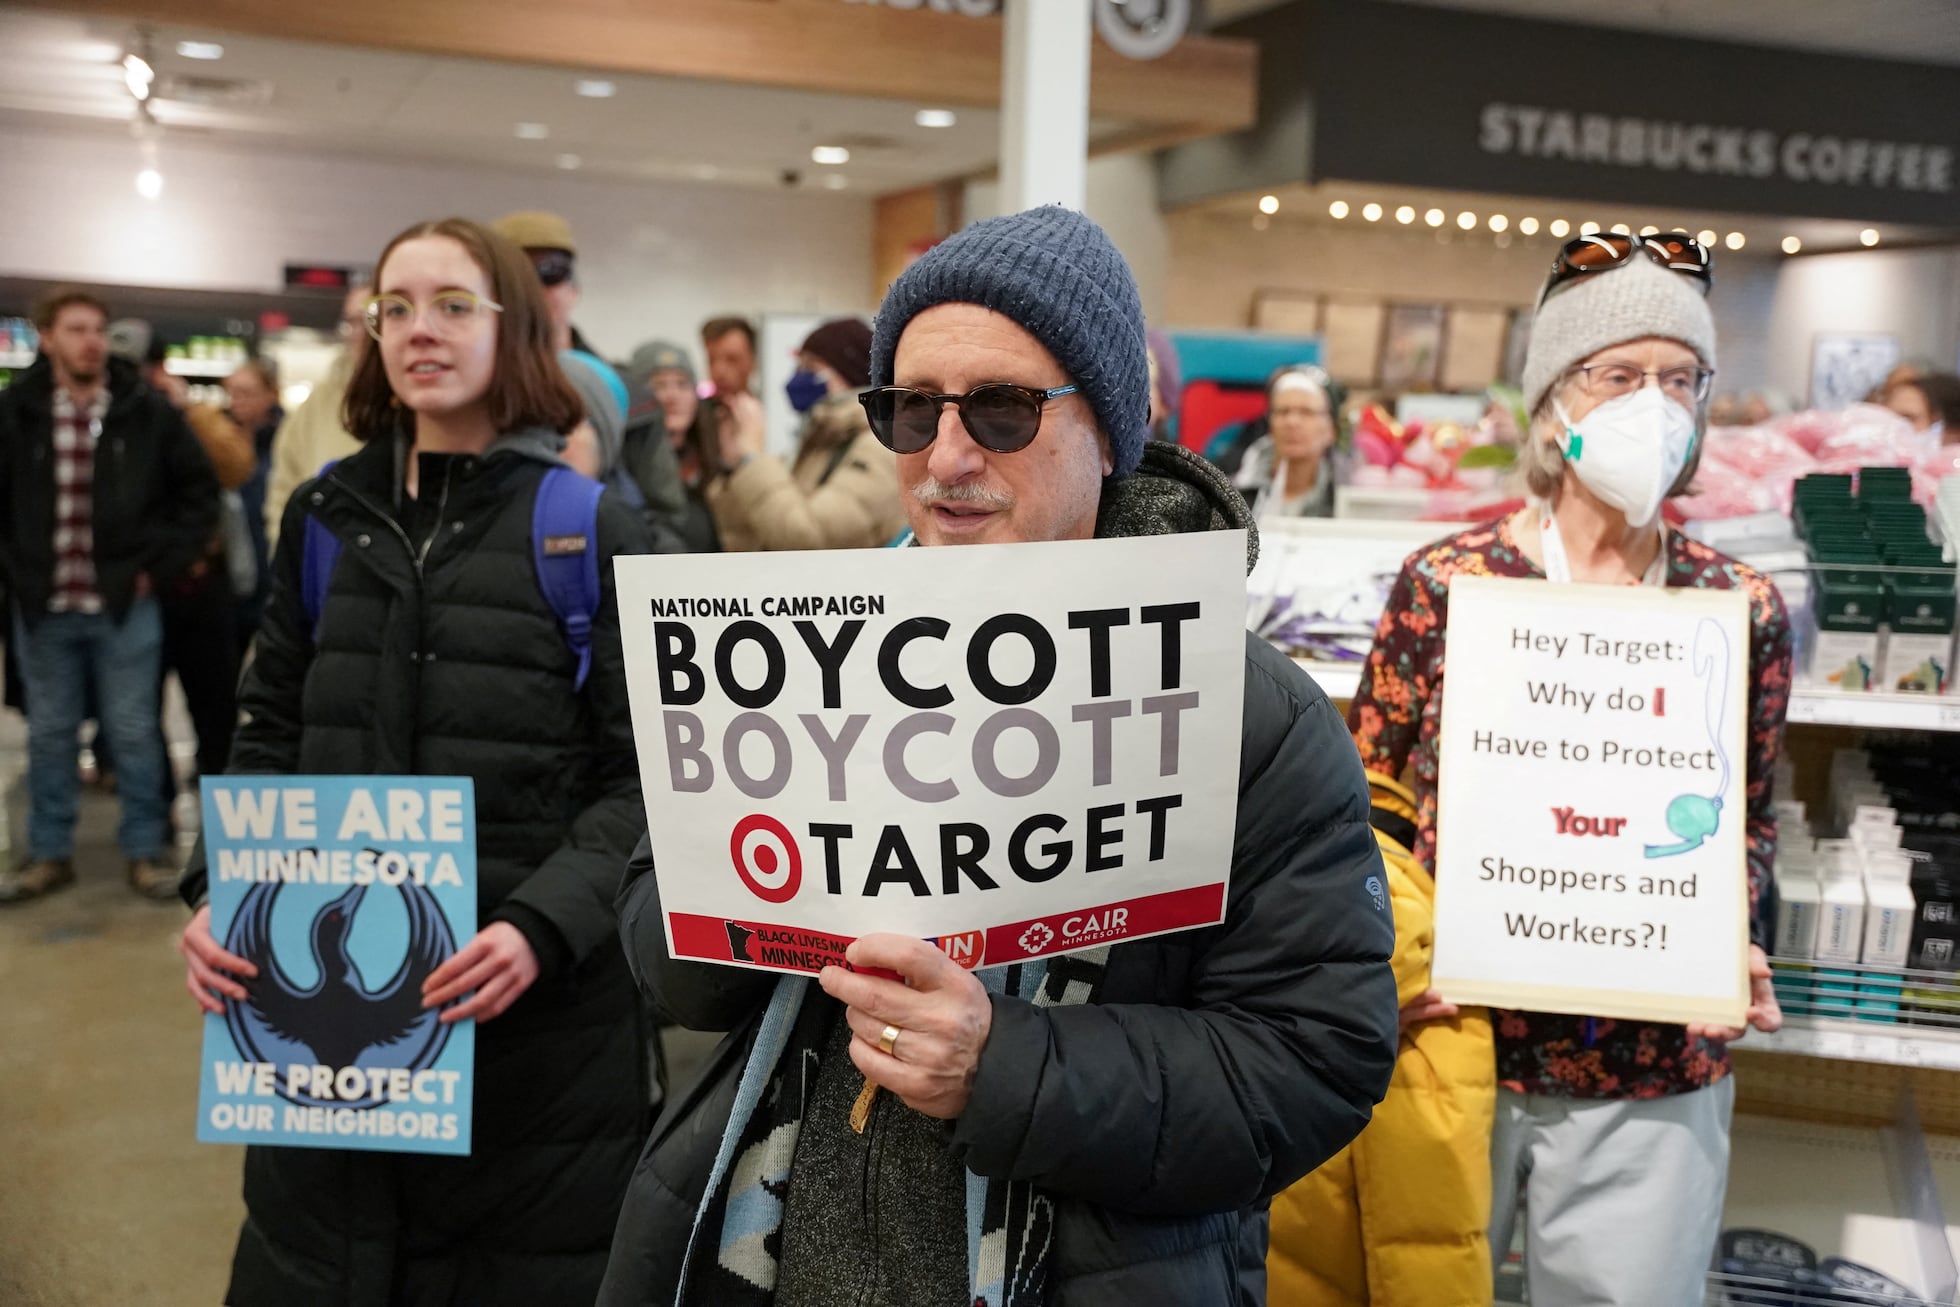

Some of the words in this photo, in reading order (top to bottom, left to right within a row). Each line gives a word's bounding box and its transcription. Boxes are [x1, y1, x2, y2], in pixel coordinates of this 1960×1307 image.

[1479, 104, 1777, 177] STARBUCKS
[1781, 132, 1953, 193] COFFEE
[650, 597, 754, 618] NATIONAL
[761, 595, 885, 617] CAMPAIGN
[654, 601, 1201, 710] BOYCOTT
[1511, 628, 1568, 658] Hey
[1579, 632, 1684, 664] Target:
[1527, 680, 1595, 713] Why
[1607, 687, 1644, 713] do
[1653, 687, 1665, 716] I
[662, 691, 1200, 803] BOYCOTT
[1473, 730, 1548, 758] Have
[1560, 738, 1590, 762] to
[1602, 740, 1716, 771] Protect
[213, 788, 318, 840] WE
[337, 788, 464, 842] ARE
[1551, 806, 1627, 838] Your
[808, 794, 1183, 897] TARGET
[217, 849, 464, 887] MINNESOTA
[1479, 857, 1626, 894] Shoppers
[1638, 873, 1697, 898] and
[758, 929, 798, 946] BLACK
[799, 935, 829, 953] LIVES
[1062, 907, 1128, 937] CAIR
[1062, 927, 1128, 946] MINNESOTA
[1504, 912, 1668, 951] Workers?!
[214, 1061, 276, 1096] WE
[287, 1063, 461, 1104] PROTECT
[210, 1103, 274, 1131] OUR
[283, 1106, 459, 1140] NEIGHBORS
